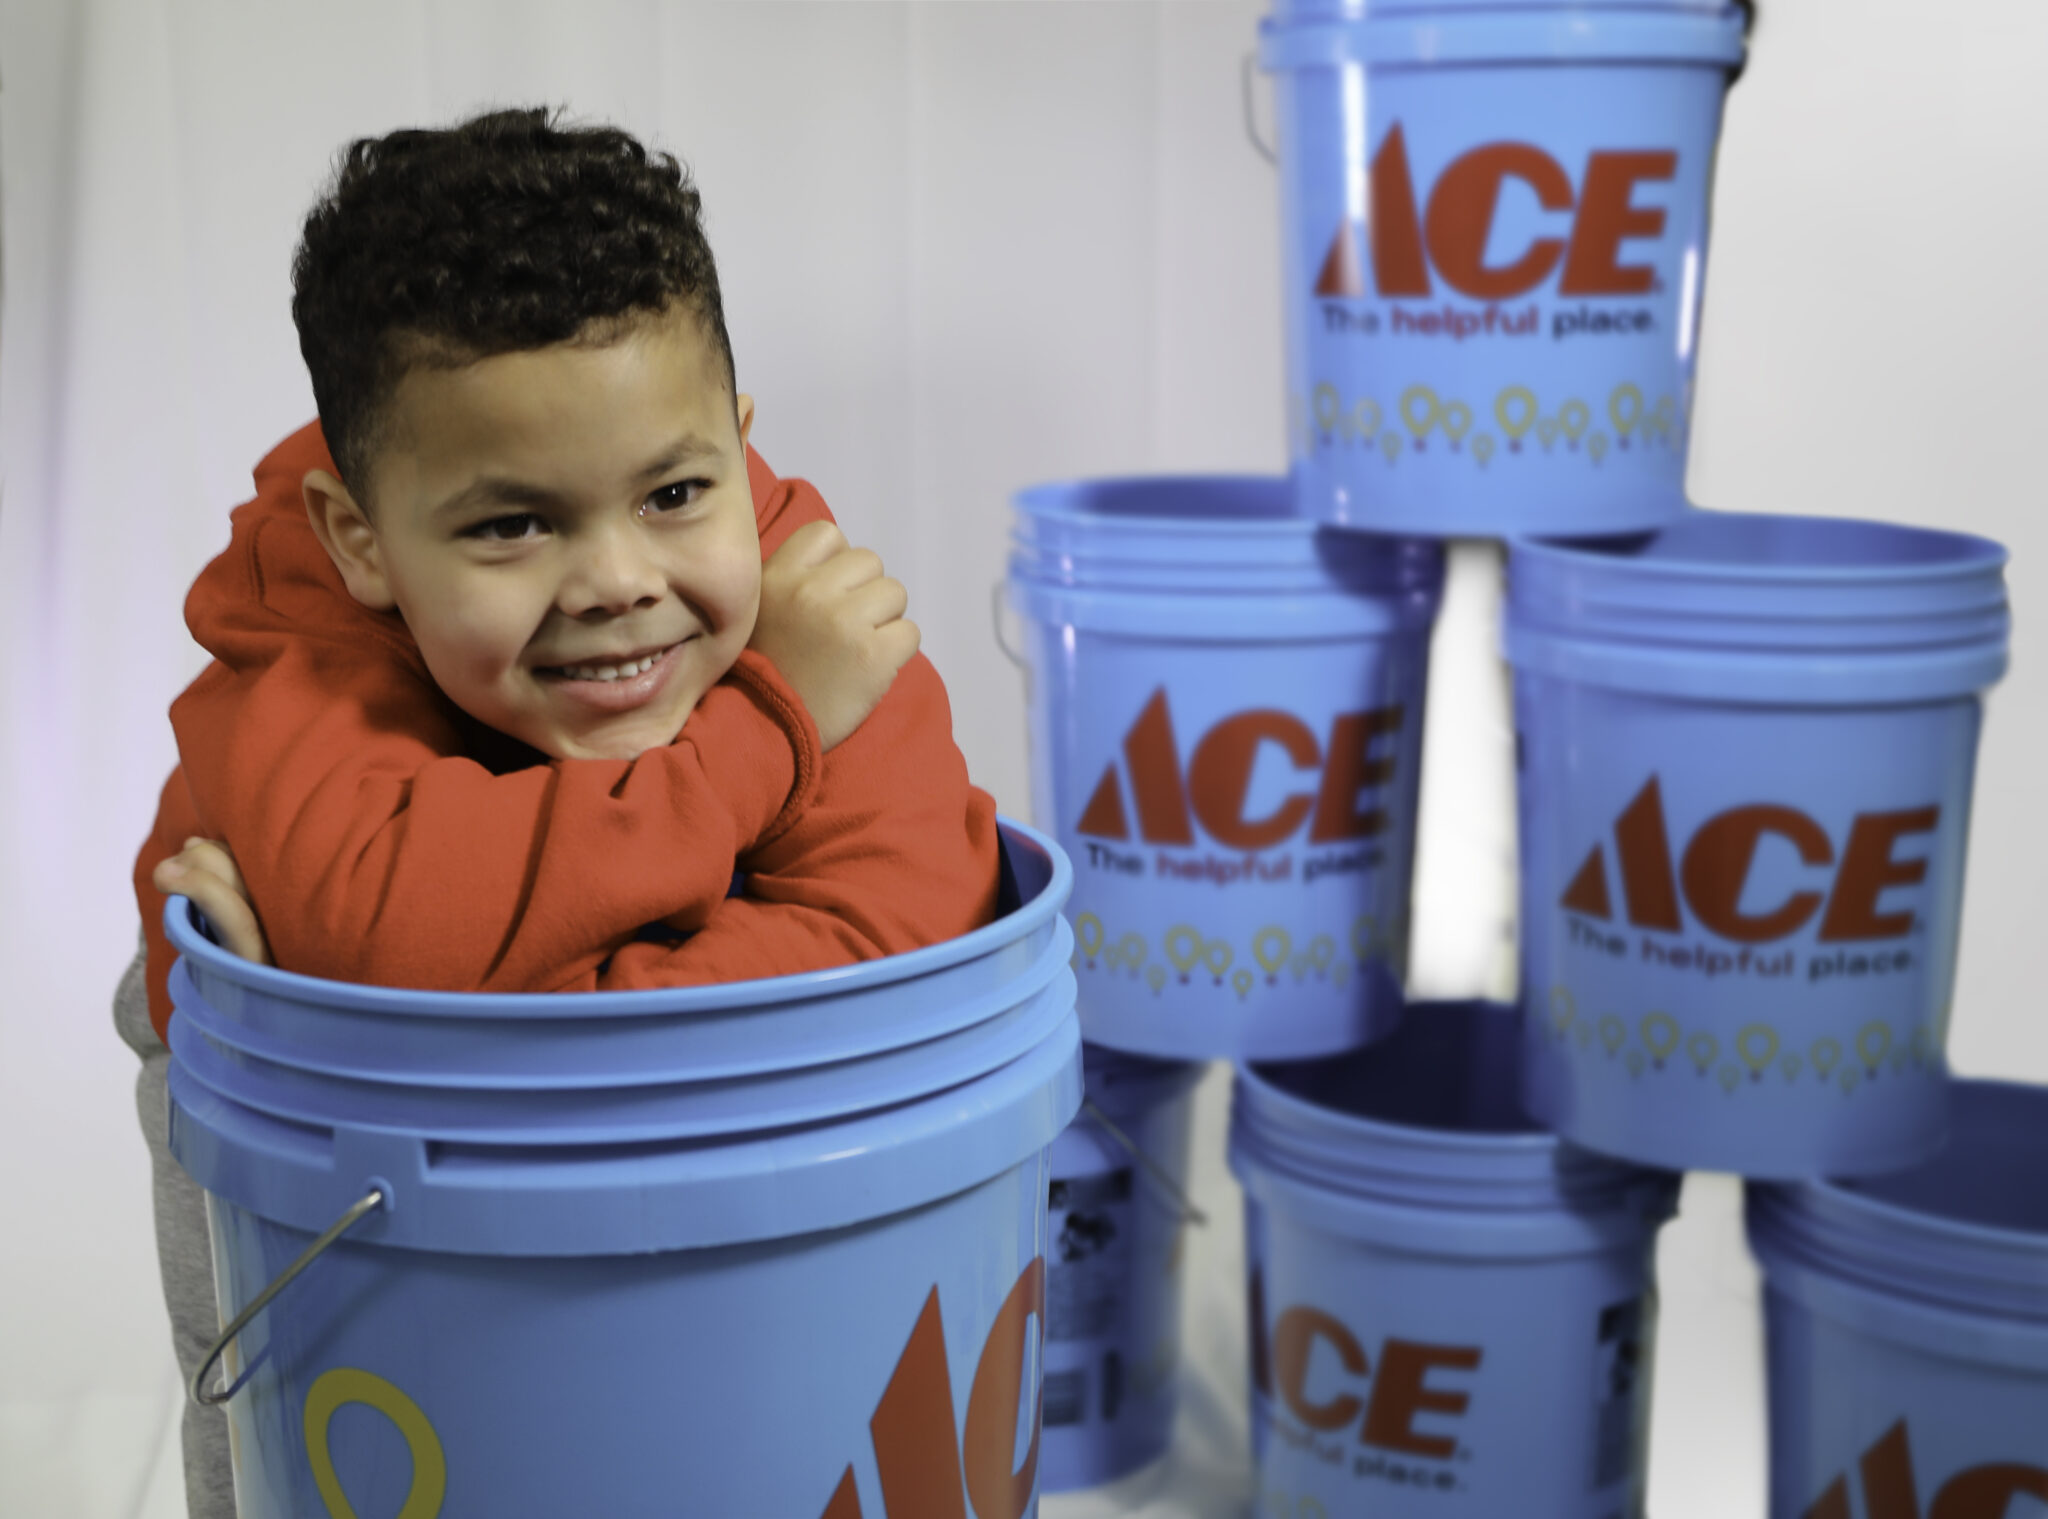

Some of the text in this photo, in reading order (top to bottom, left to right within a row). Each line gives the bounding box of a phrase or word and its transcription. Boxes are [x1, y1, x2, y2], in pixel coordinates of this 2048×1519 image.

[1313, 117, 1678, 300] ACE
[1322, 304, 1380, 335] The
[1390, 302, 1541, 343] helpful
[1076, 683, 1403, 850] ACE
[1086, 843, 1144, 876] The
[1155, 849, 1292, 886] helpful
[1559, 769, 1940, 944] ACE
[1566, 916, 1628, 957] The
[1640, 936, 1794, 979] helpful
